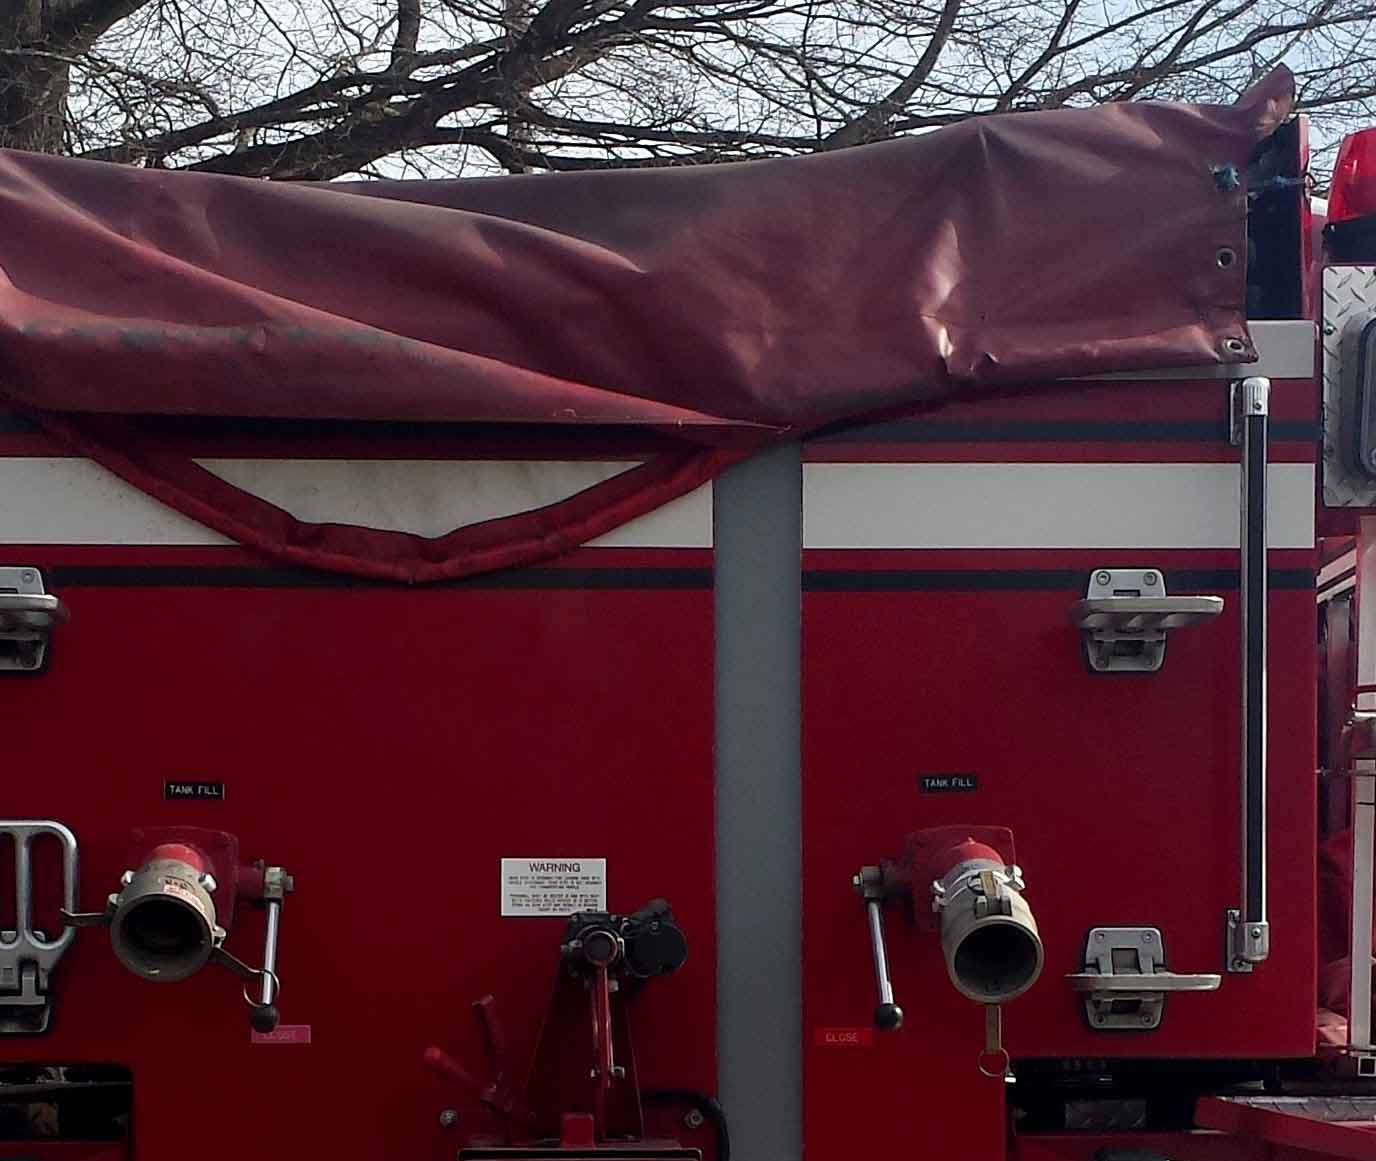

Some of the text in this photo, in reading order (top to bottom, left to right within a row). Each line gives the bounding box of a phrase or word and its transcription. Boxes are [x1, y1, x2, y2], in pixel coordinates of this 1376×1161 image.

[923, 777, 974, 788] TANK FILL
[169, 785, 221, 796] TANK FILL
[528, 862, 582, 873] WARNING
[825, 1032, 859, 1042] CLOSE
